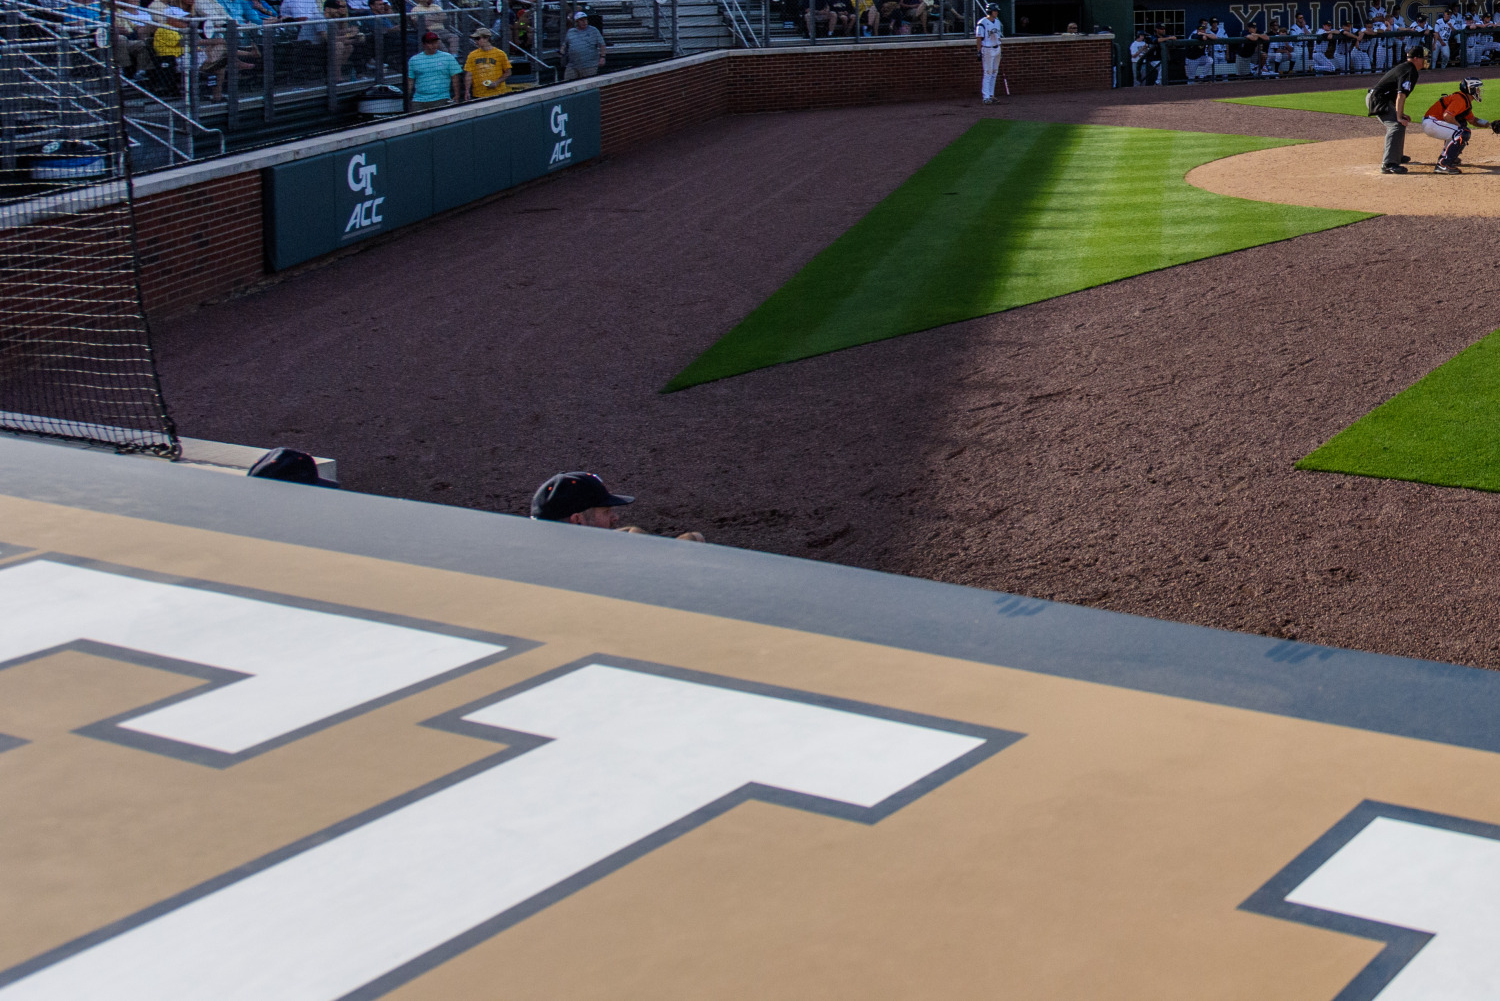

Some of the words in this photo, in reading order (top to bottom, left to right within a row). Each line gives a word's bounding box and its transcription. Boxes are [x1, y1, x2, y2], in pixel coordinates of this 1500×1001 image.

[551, 105, 568, 137] GT
[550, 138, 572, 164] ACC
[348, 153, 377, 195] GT
[345, 197, 385, 233] ACC
